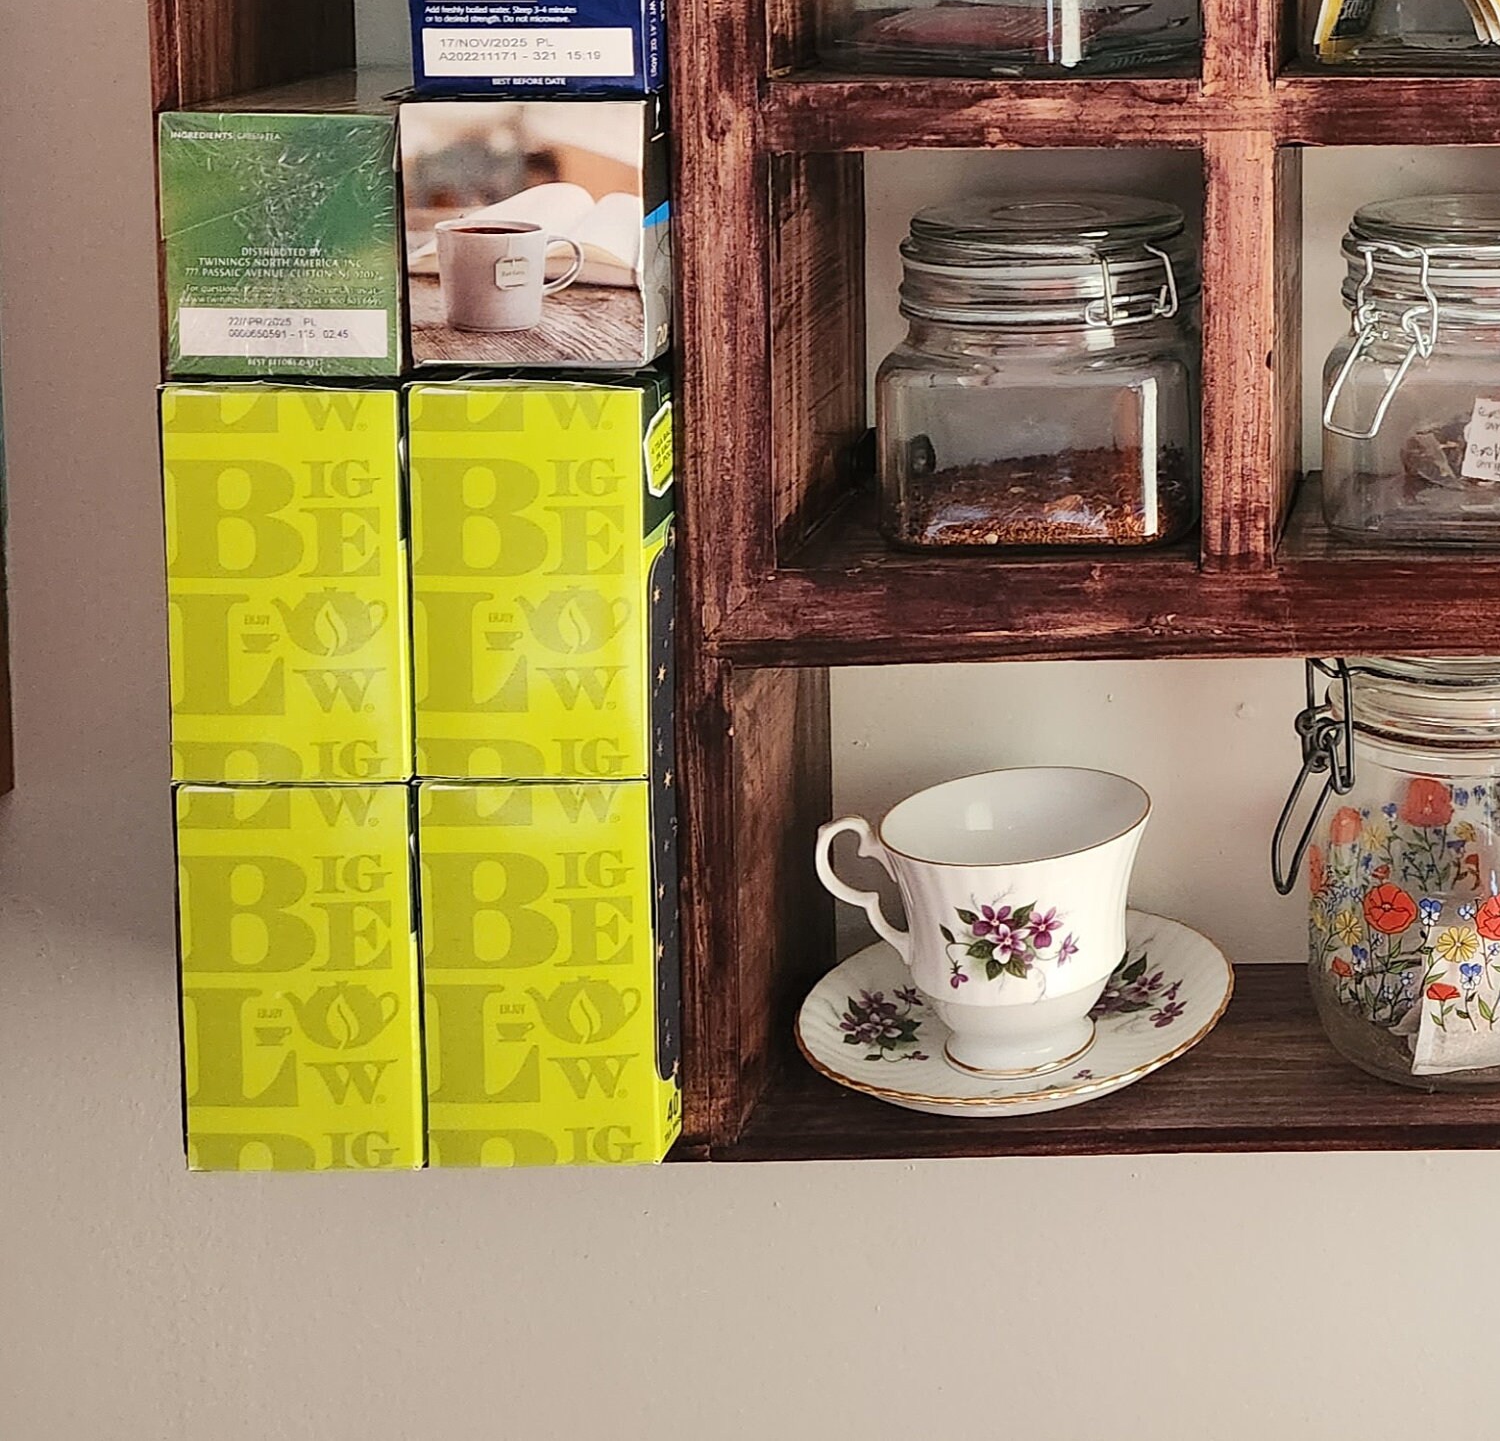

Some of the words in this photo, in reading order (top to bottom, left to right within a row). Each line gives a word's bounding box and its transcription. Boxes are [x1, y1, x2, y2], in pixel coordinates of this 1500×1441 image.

[424, 6, 440, 14] Add
[441, 5, 464, 15] freshly
[512, 5, 533, 15] Steep
[548, 6, 577, 14] minutes
[435, 15, 442, 23] to
[444, 14, 469, 23] desired
[503, 15, 514, 23] Do
[440, 38, 528, 48] 17/NOV/2025
[536, 37, 554, 47] PL
[439, 51, 517, 61] A202211171
[533, 51, 557, 61] 321
[567, 50, 602, 60] 15:19
[492, 77, 511, 85] BEST
[512, 78, 544, 86] BEFORE
[545, 78, 566, 86] DATE
[199, 257, 251, 267] TWININGS
[253, 258, 290, 267] NORTH
[293, 258, 338, 268] AMERICA
[202, 267, 241, 277] PASSAIC
[303, 317, 317, 326] PL
